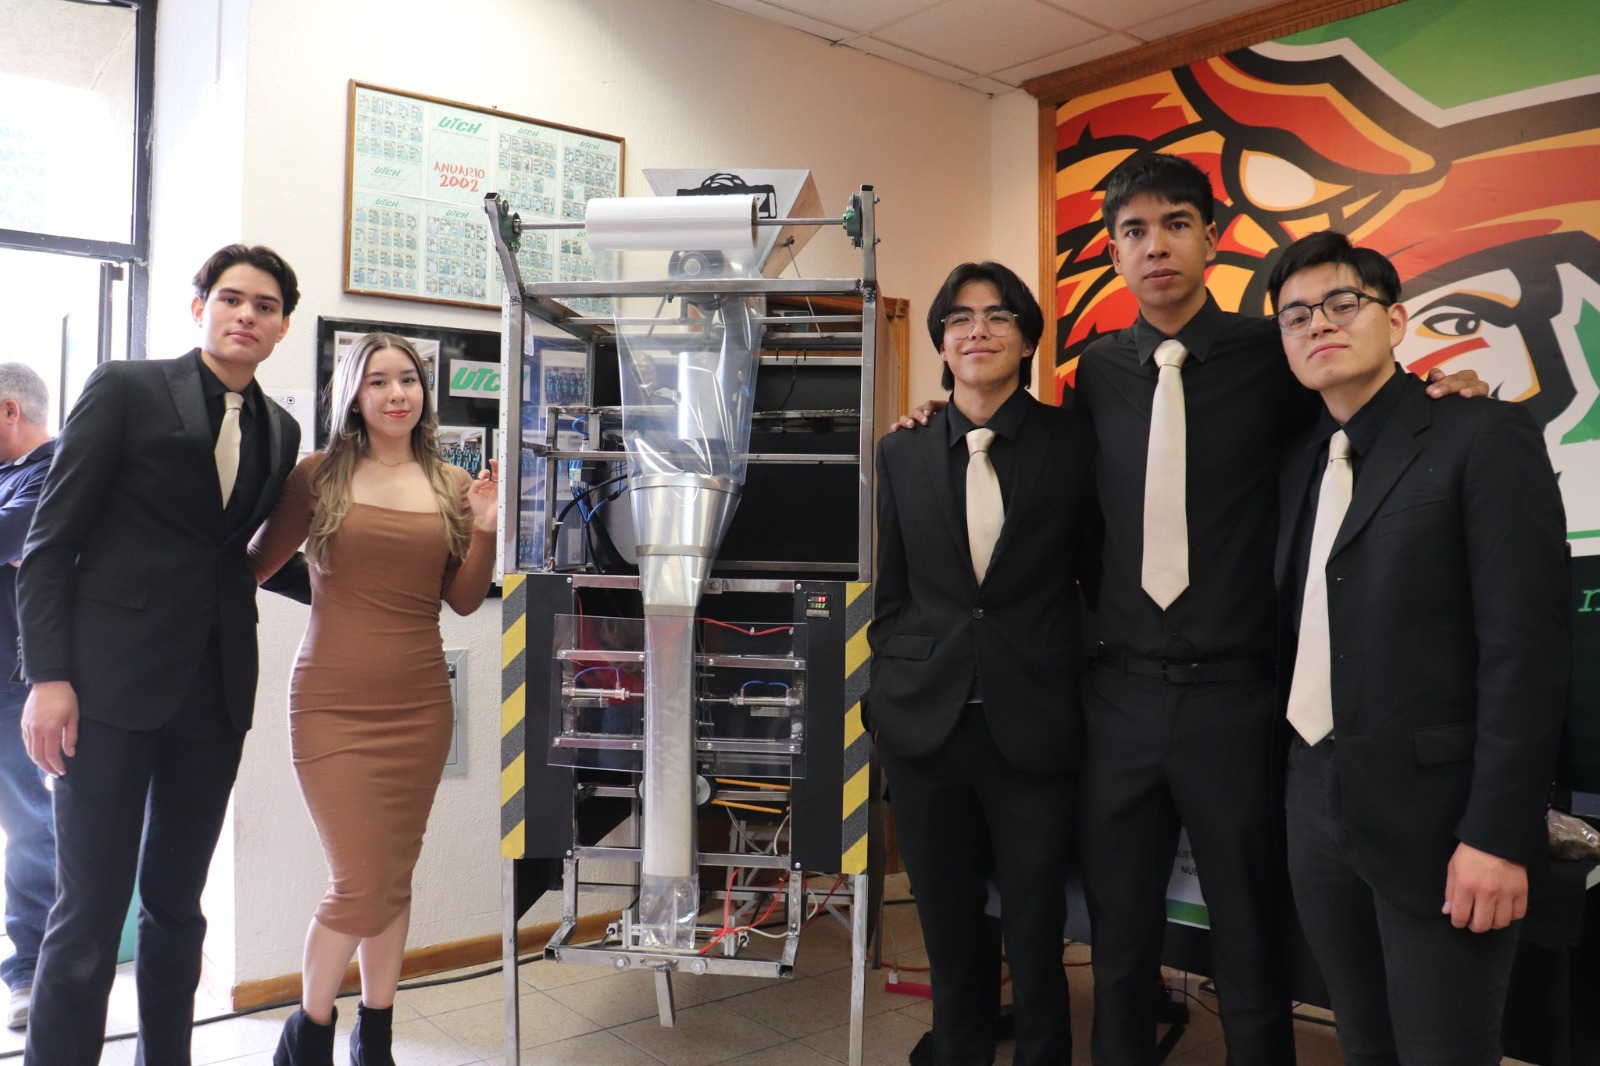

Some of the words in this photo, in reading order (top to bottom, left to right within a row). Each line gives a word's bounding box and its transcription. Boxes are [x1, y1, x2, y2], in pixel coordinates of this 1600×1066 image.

[438, 116, 482, 134] UTCH
[517, 128, 540, 137] UTCH
[579, 141, 601, 150] UTCH
[374, 166, 401, 177] UTCH
[434, 161, 485, 179] ANUARIO
[440, 174, 479, 192] 2002
[375, 198, 400, 208] UTCH
[445, 209, 470, 219] UTCH
